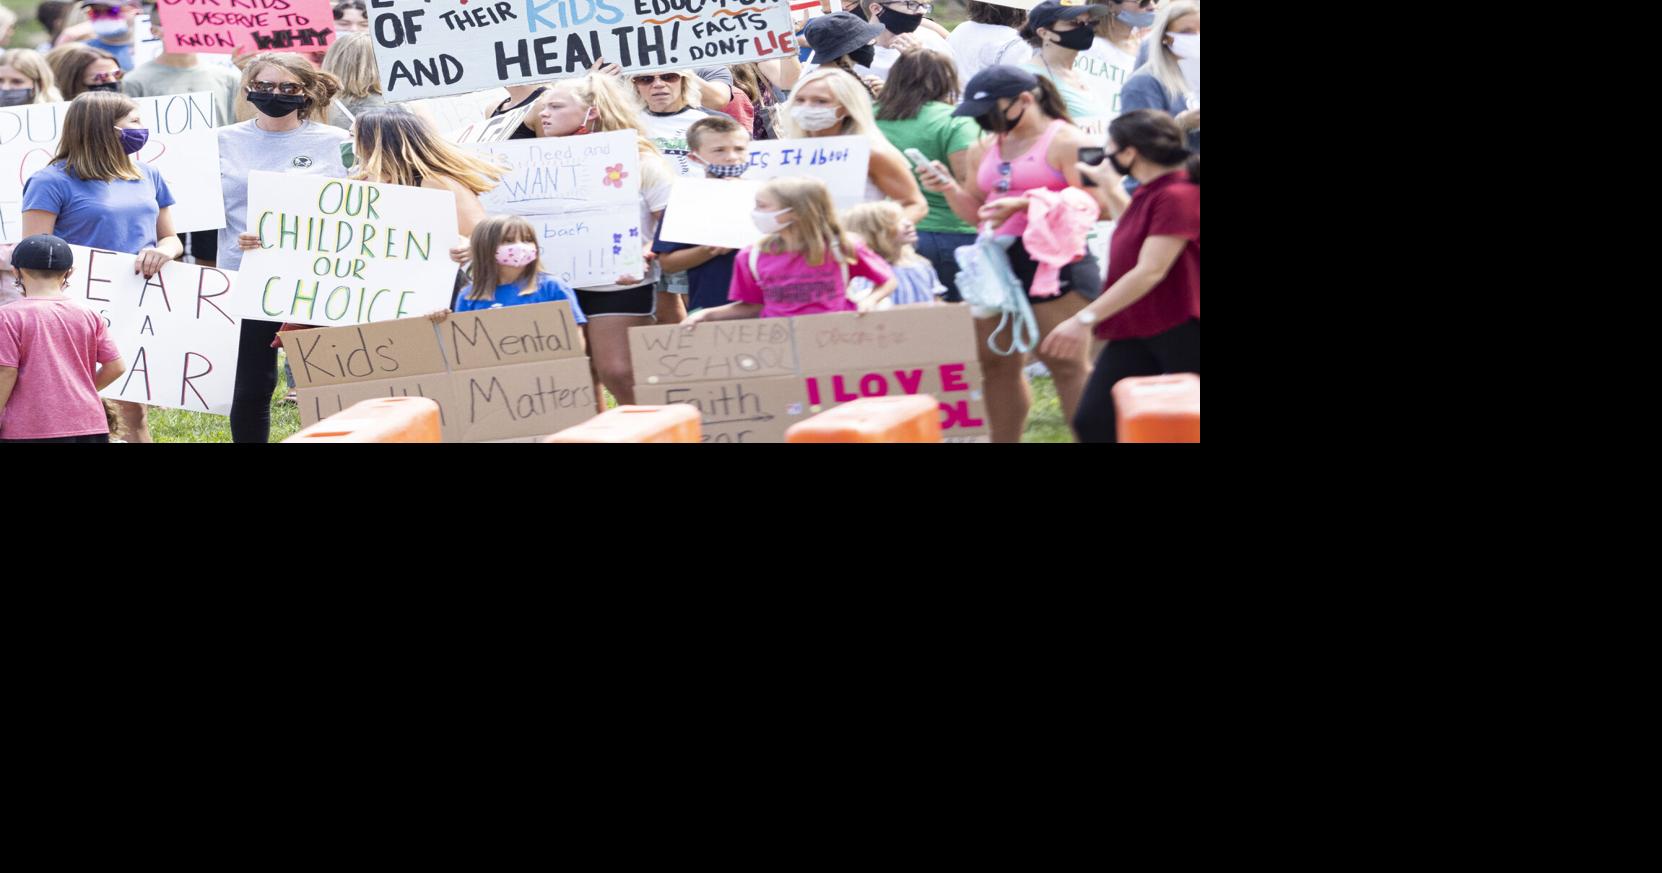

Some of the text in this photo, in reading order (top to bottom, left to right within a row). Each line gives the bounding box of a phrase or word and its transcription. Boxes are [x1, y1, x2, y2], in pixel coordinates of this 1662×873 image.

[190, 12, 310, 27] DESERVE TO
[374, 9, 425, 48] OF
[439, 2, 517, 31] THEIR
[691, 12, 768, 39] FACTS
[175, 27, 333, 50] KNOW WHY
[688, 30, 796, 61] DON'T LIE
[387, 21, 679, 92] AND HEALTH!
[502, 163, 581, 197] WANT
[318, 181, 380, 220] OUR
[258, 211, 431, 261] CHILDREN
[313, 256, 365, 280] OUR
[86, 249, 235, 325] EAR
[140, 314, 155, 336] A
[642, 328, 694, 351] WE
[713, 322, 790, 346] NEED
[295, 308, 572, 383] Kids' Mental
[657, 346, 796, 378] SCHOOL
[470, 376, 591, 424] Matters
[831, 363, 969, 403] LOVE
